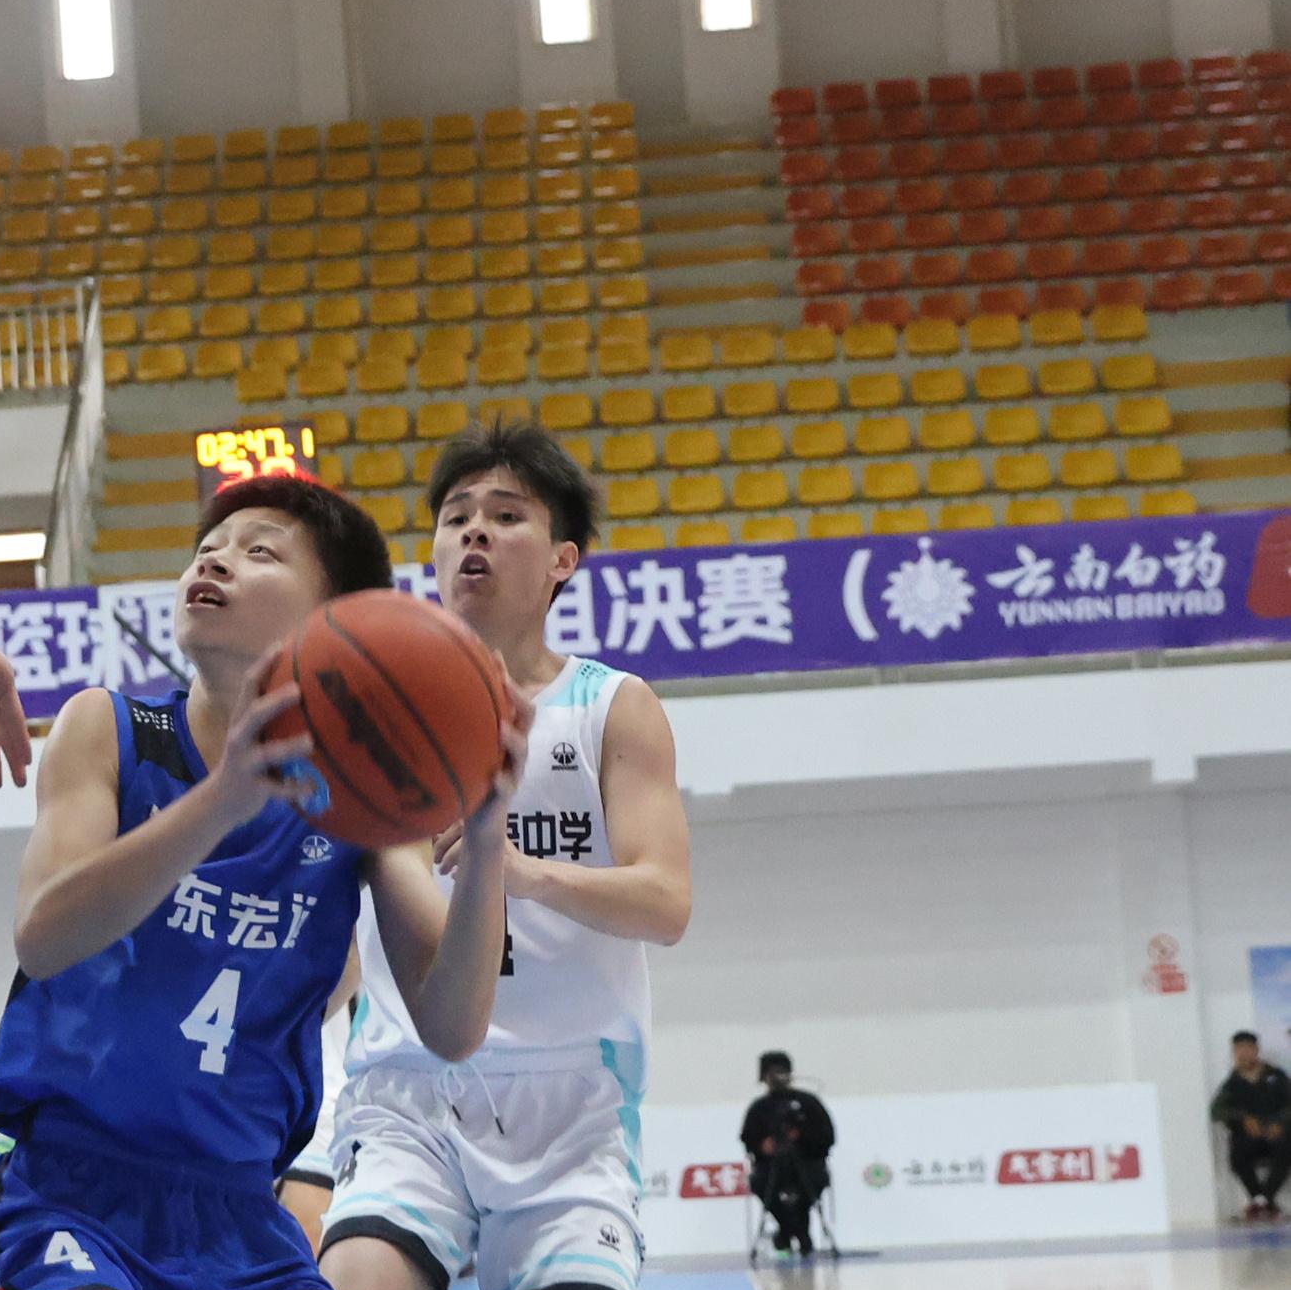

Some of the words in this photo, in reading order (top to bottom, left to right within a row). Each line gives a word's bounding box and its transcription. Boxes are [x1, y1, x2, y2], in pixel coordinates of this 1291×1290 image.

[985, 530, 1227, 598] 云南白药
[997, 596, 1113, 628] YUNNAN
[1114, 587, 1226, 620] BAIYAO
[179, 967, 242, 1076] 4
[43, 1229, 95, 1273] 4
